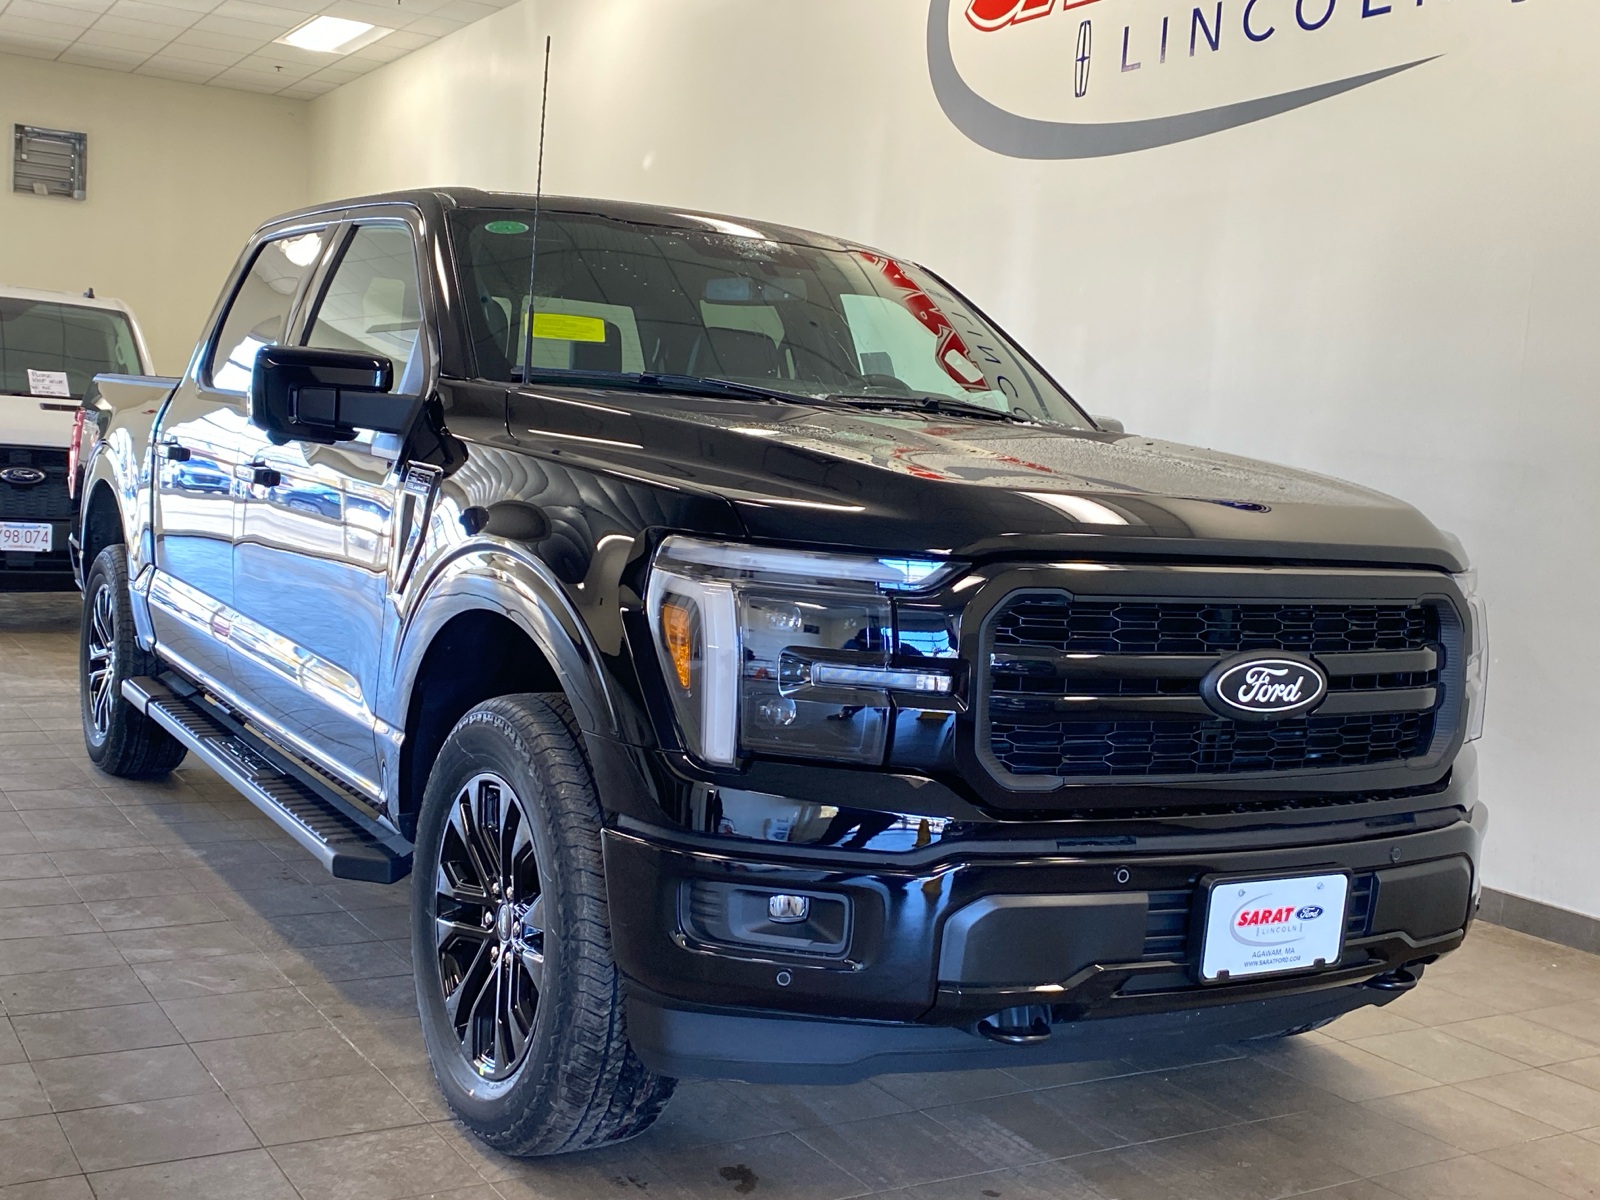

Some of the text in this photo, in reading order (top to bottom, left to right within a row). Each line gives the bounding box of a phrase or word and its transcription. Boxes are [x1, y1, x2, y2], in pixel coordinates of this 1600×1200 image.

[1120, 0, 1460, 73] LINCO
[24, 530, 49, 544] 074
[1238, 667, 1304, 702] Ford
[1237, 906, 1295, 927] SARAT
[1300, 907, 1319, 918] Ford
[1262, 926, 1297, 934] LINCOLN
[1252, 949, 1283, 958] AGAWAM,
[1244, 955, 1301, 967] WWW.SARATFORD.COM
